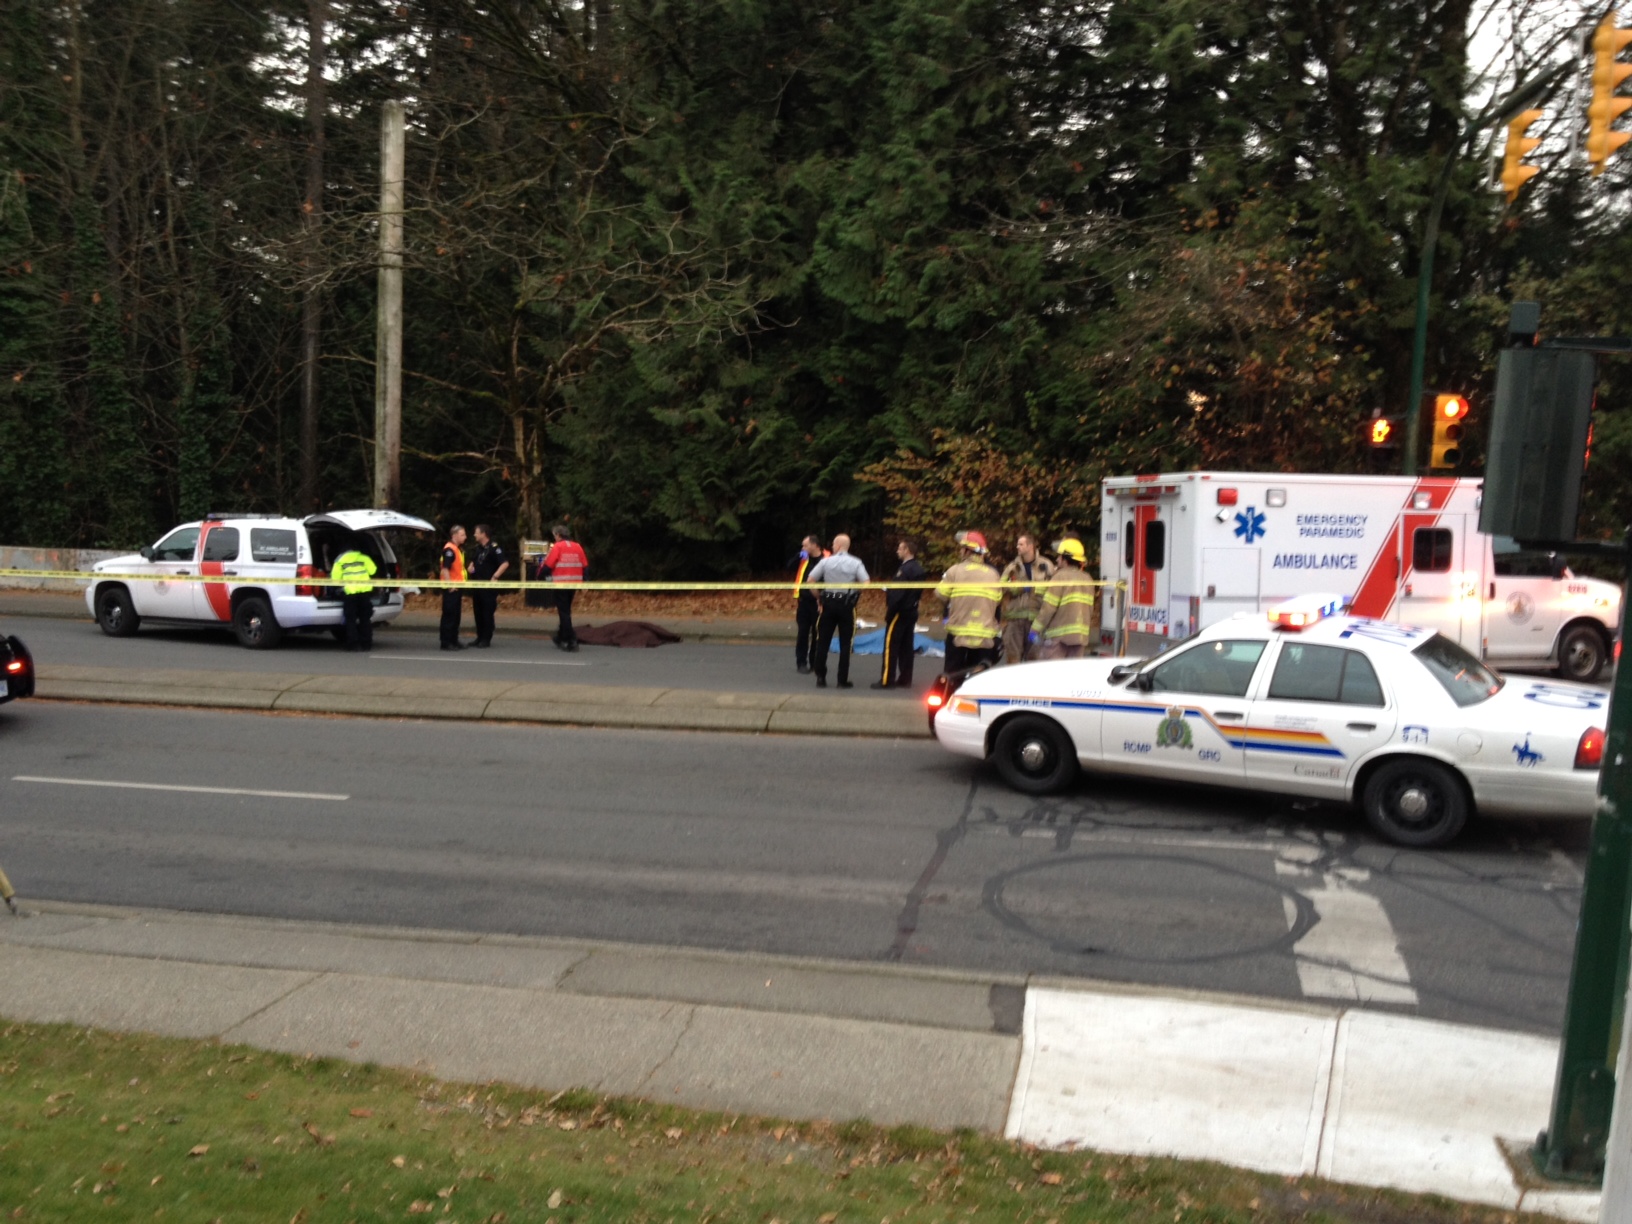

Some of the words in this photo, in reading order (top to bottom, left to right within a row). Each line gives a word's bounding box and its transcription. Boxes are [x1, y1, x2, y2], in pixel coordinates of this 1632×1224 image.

[1296, 514, 1368, 526] EMERGENCY
[1299, 527, 1365, 539] PARAMEDIC
[1273, 553, 1358, 569] AMBULANCE
[1011, 699, 1050, 708] POLICE
[1123, 741, 1151, 754] RCMP
[1198, 749, 1221, 763] GRC
[1293, 763, 1340, 779] Canada
